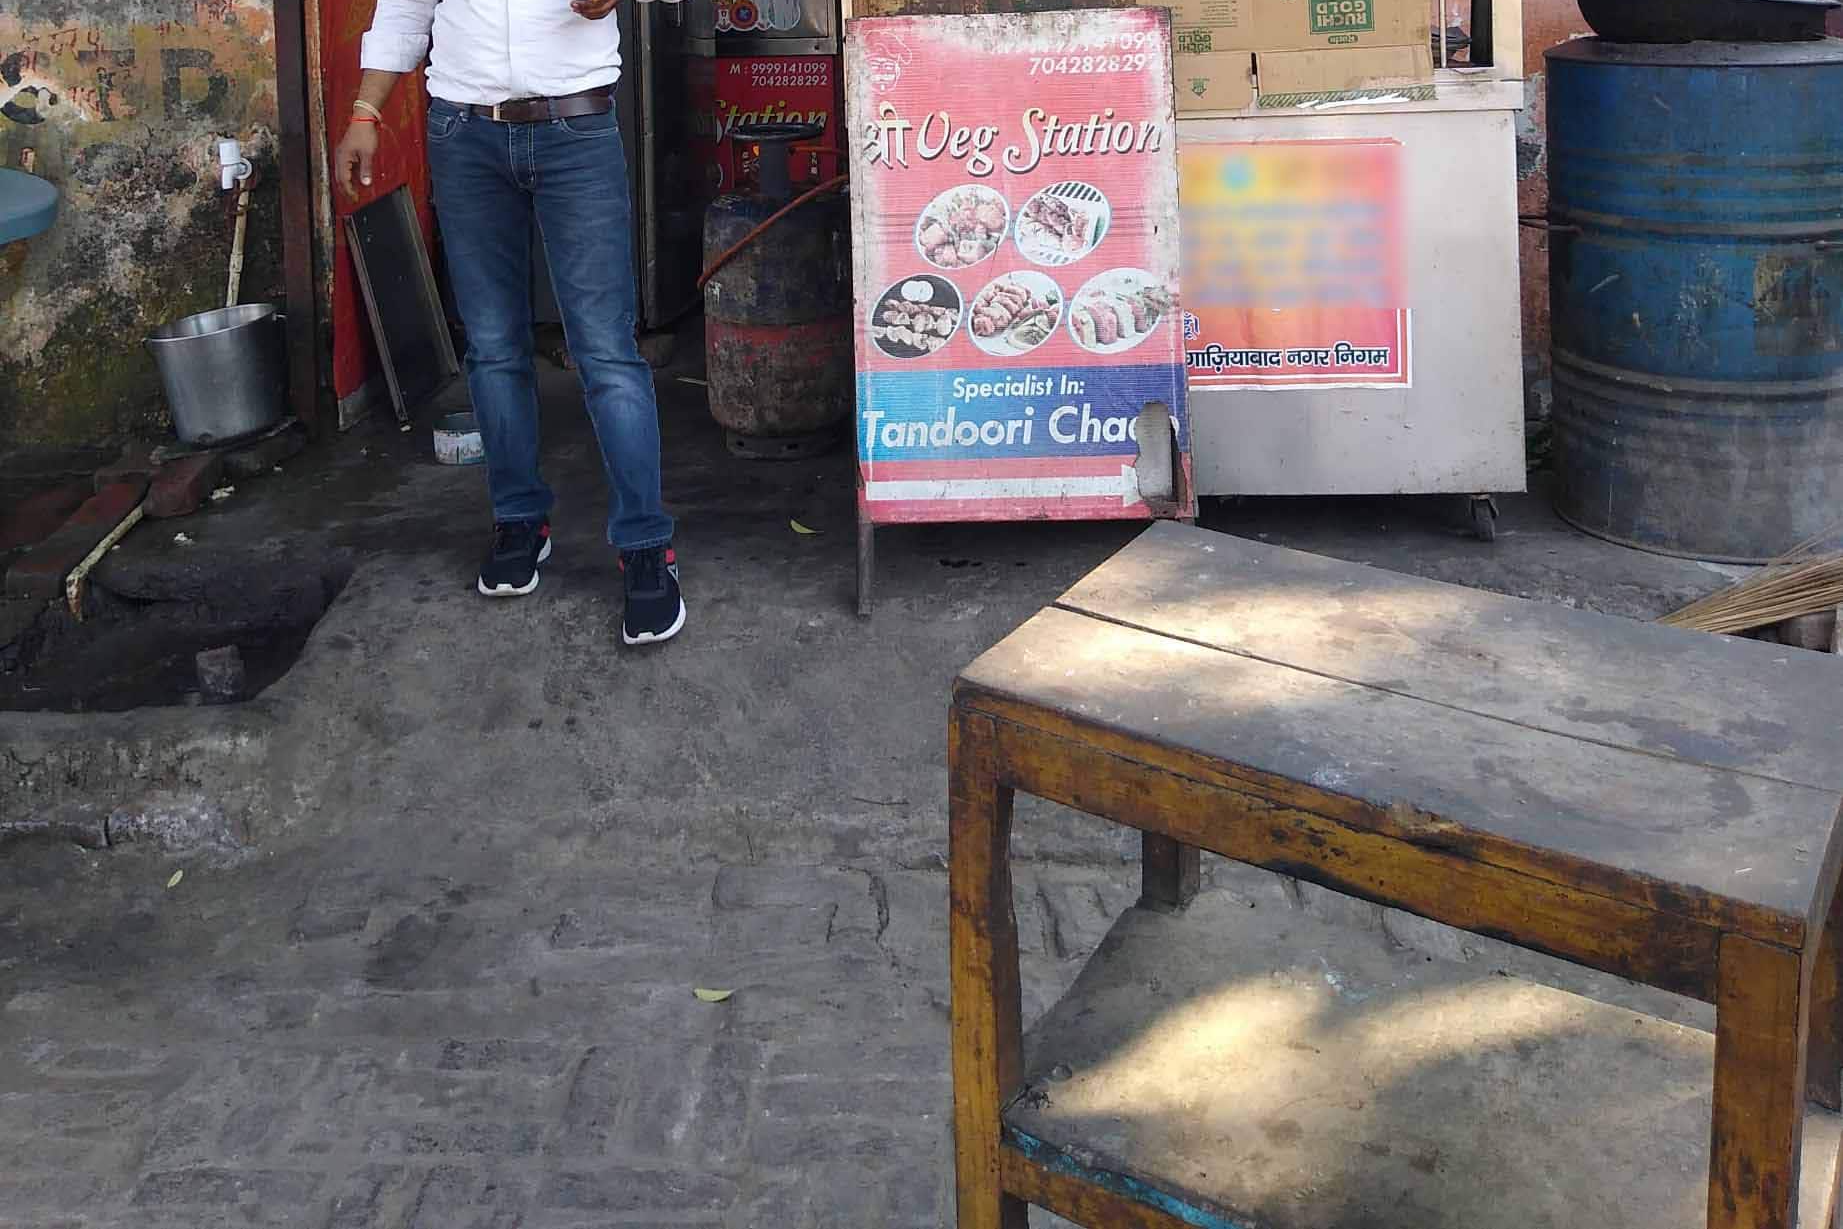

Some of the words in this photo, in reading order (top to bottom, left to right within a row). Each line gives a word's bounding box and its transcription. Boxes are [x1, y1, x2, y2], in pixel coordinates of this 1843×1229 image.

[1316, 0, 1366, 14] GOLD
[1316, 12, 1367, 27] RUCHI
[751, 62, 827, 75] 9999141099
[751, 75, 828, 87] 7042828292
[1002, 107, 1161, 174] Station
[1287, 350, 1330, 366] नगर
[1335, 343, 1389, 366] निगम
[953, 374, 1053, 403] Specialist
[1060, 378, 1085, 396] In:
[862, 406, 1035, 449] Tandoori
